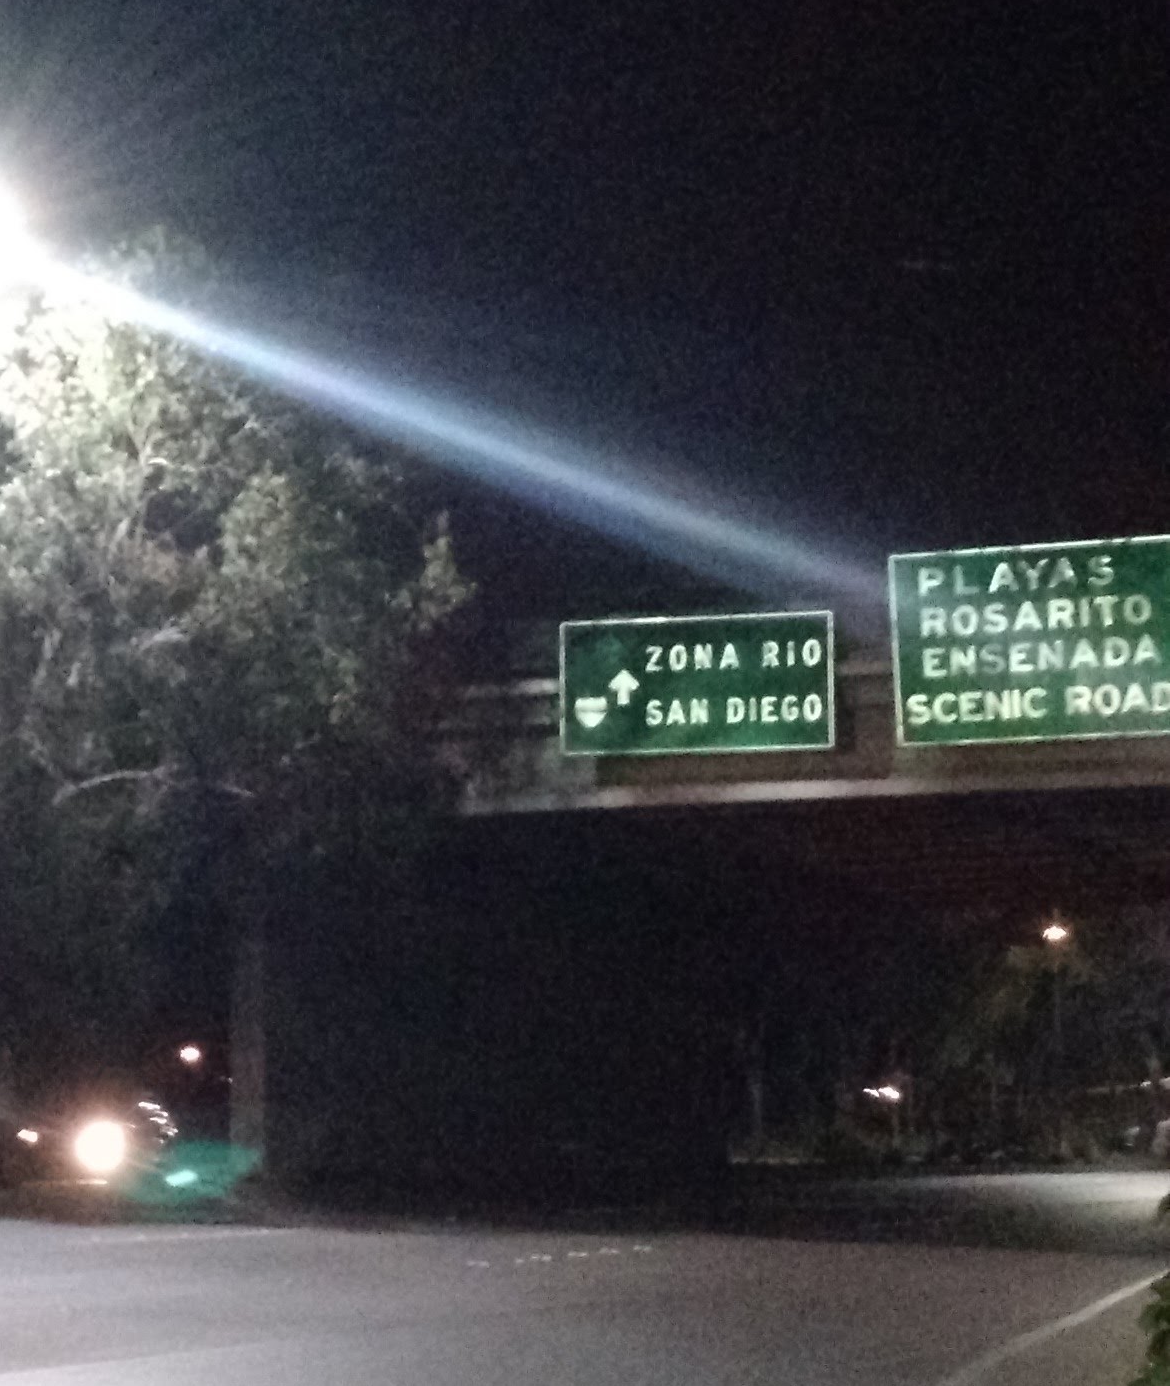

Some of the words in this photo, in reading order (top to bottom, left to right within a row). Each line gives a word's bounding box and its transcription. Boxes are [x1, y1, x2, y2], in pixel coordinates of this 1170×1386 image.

[918, 555, 1114, 597] PLAYAS
[920, 594, 1152, 638] ROSARITO
[645, 642, 740, 672] ZONA
[762, 638, 822, 668] RIO
[922, 634, 1161, 679] ENSENADA
[645, 698, 709, 727] SAN
[726, 693, 823, 725] DIEGO
[905, 687, 1048, 725] SCENIC
[1064, 681, 1170, 717] ROAD
